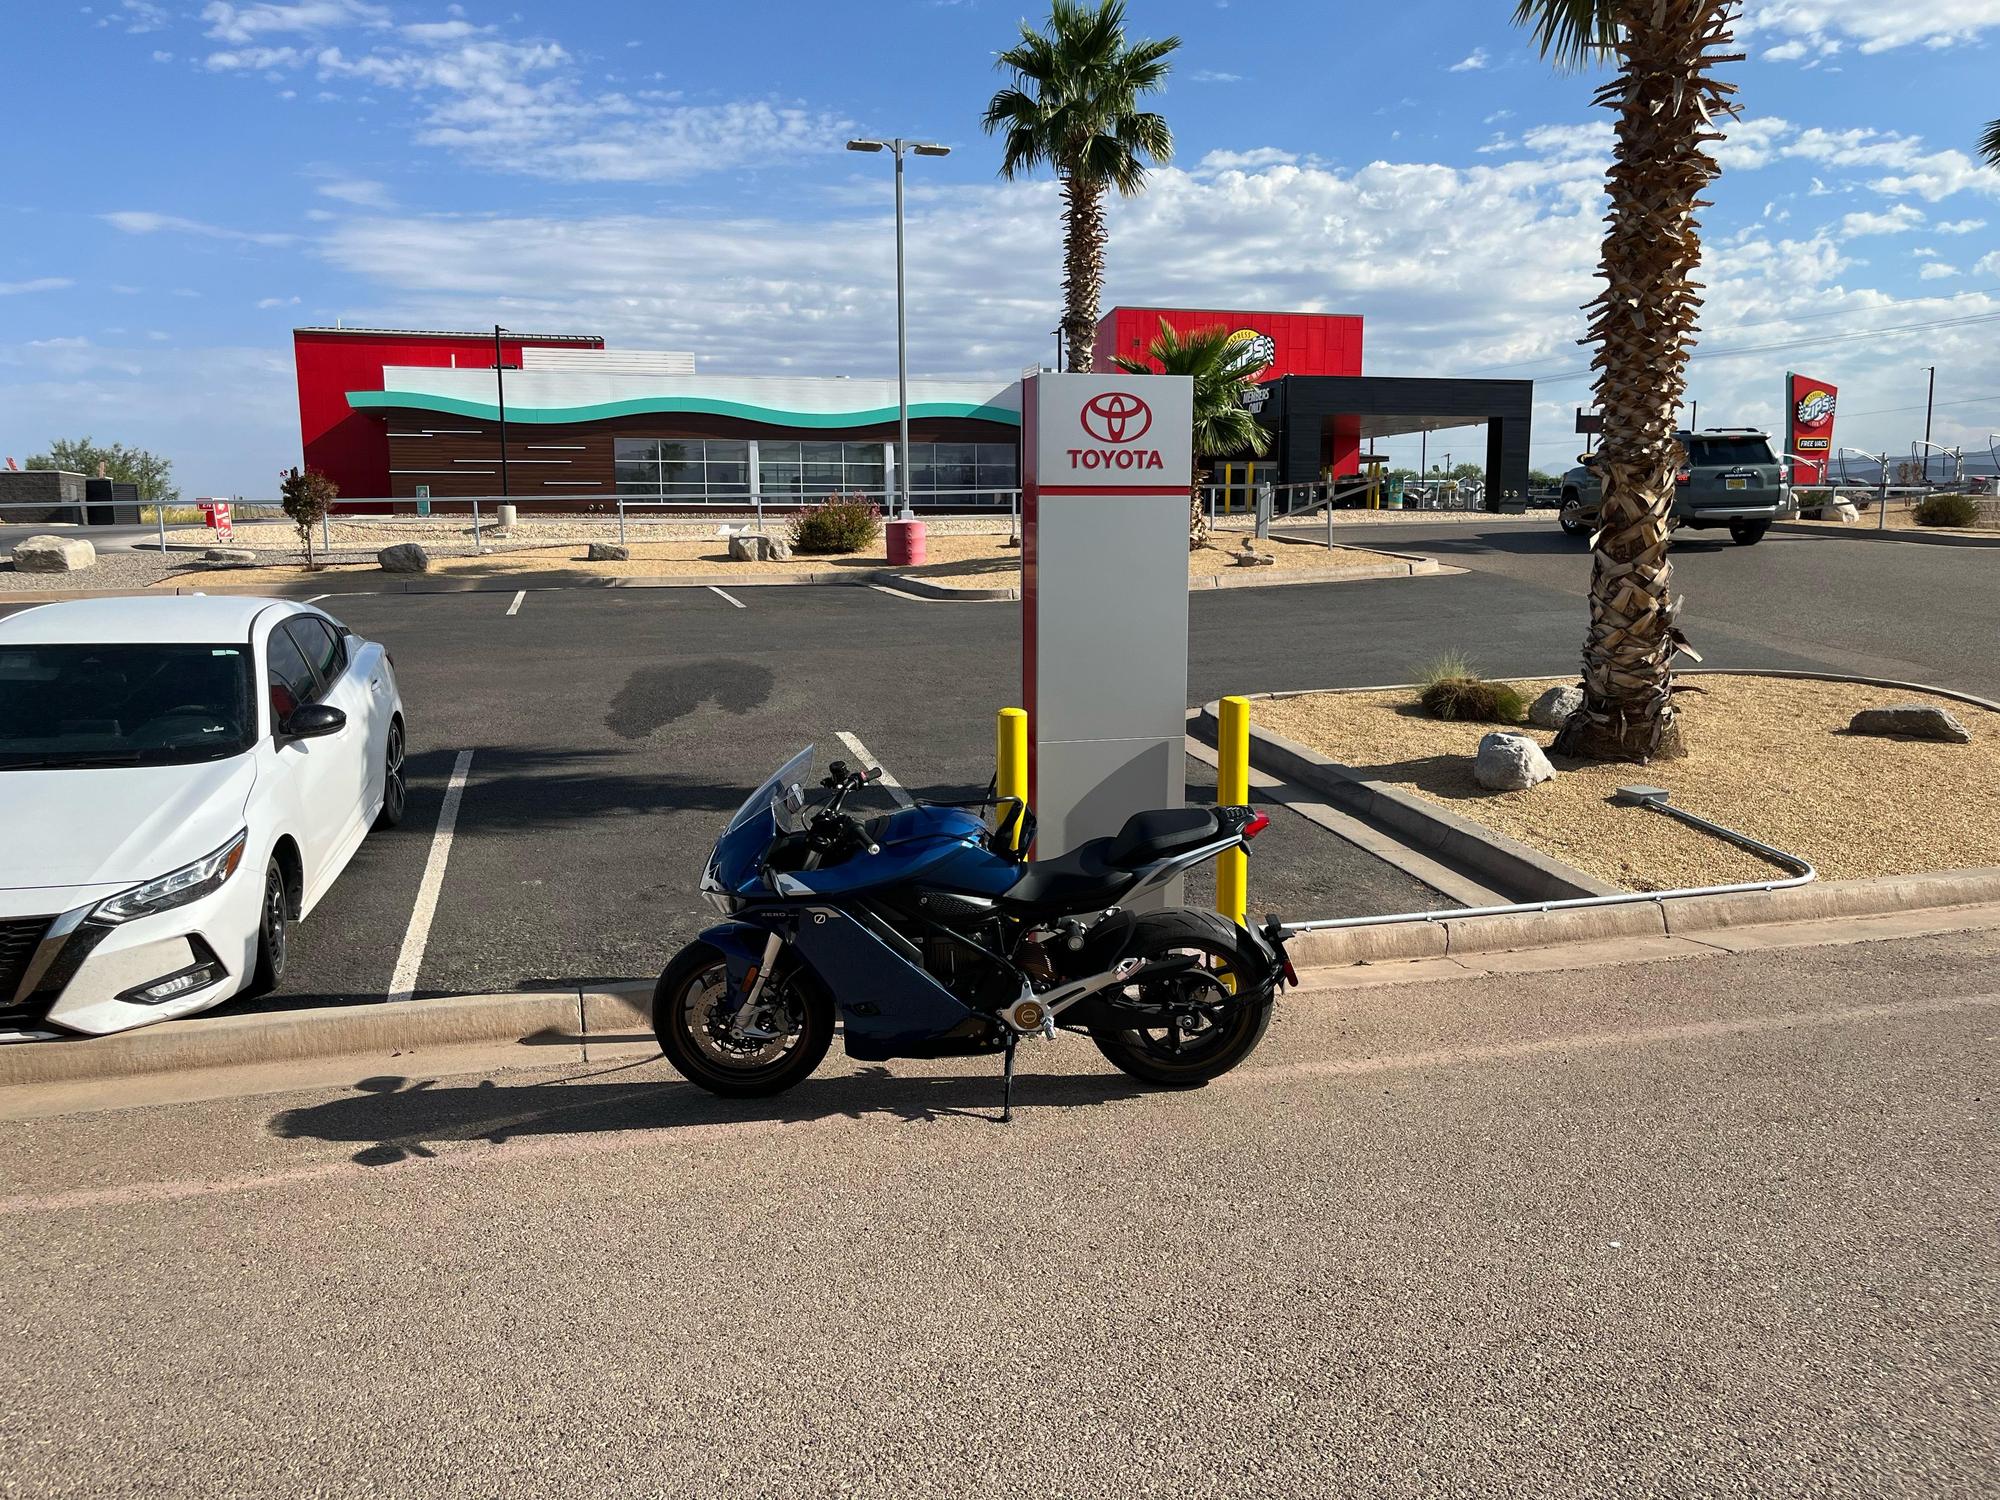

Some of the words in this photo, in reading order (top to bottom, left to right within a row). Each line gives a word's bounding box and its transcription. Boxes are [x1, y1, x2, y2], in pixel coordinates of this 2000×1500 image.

[1243, 388, 1270, 404] MEMBERS
[1249, 401, 1263, 414] ONLY
[1804, 397, 1830, 420] ZIPS
[1067, 449, 1164, 469] TOYOTA
